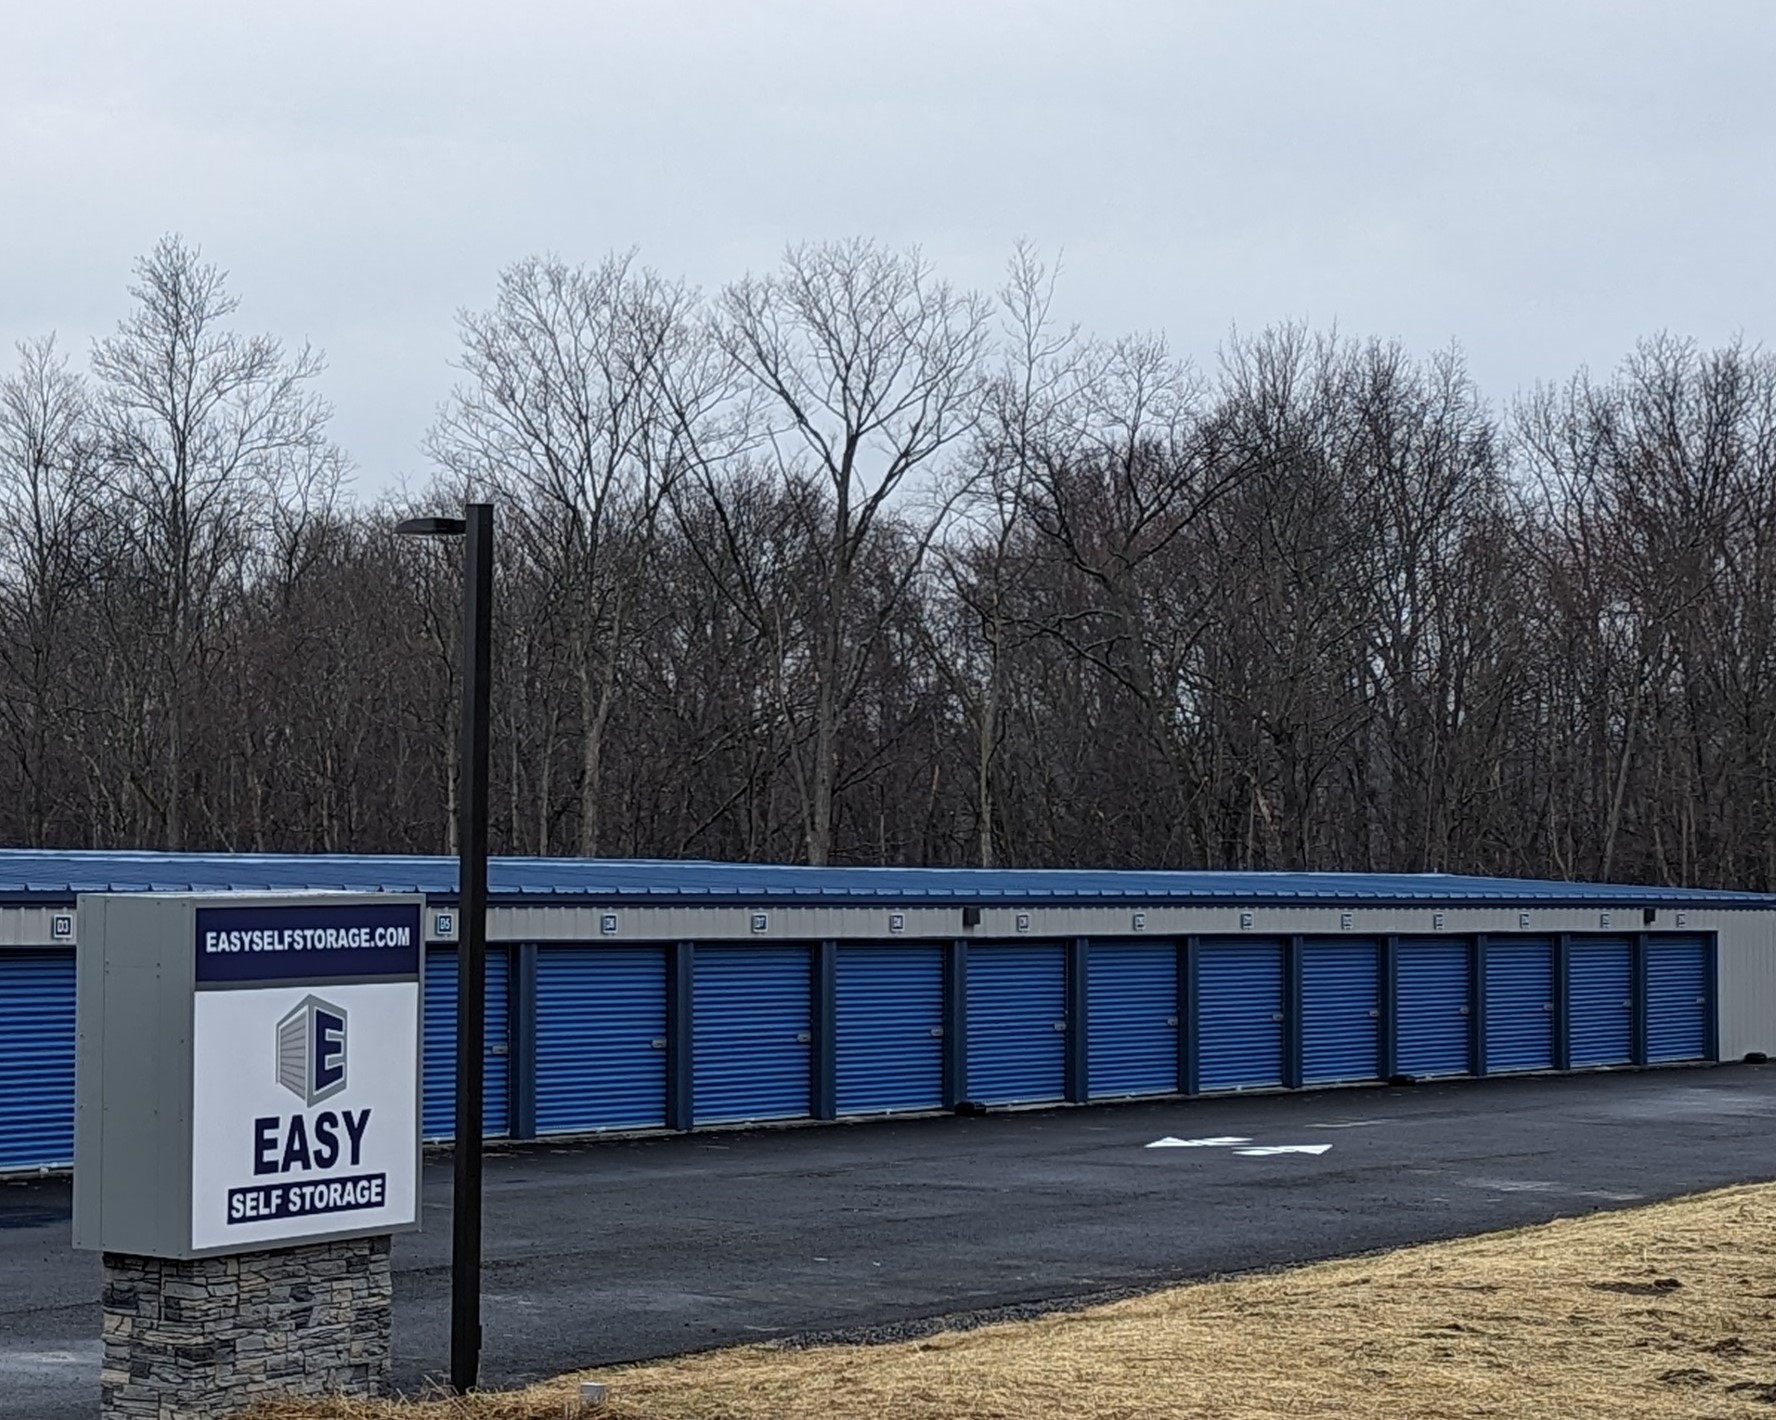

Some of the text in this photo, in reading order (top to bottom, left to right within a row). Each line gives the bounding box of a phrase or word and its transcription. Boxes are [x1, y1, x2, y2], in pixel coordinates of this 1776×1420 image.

[206, 927, 410, 952] EASYSELFSTORAGE.COM
[253, 1108, 372, 1176] EASY
[231, 1178, 383, 1218] SELF STORAGE
